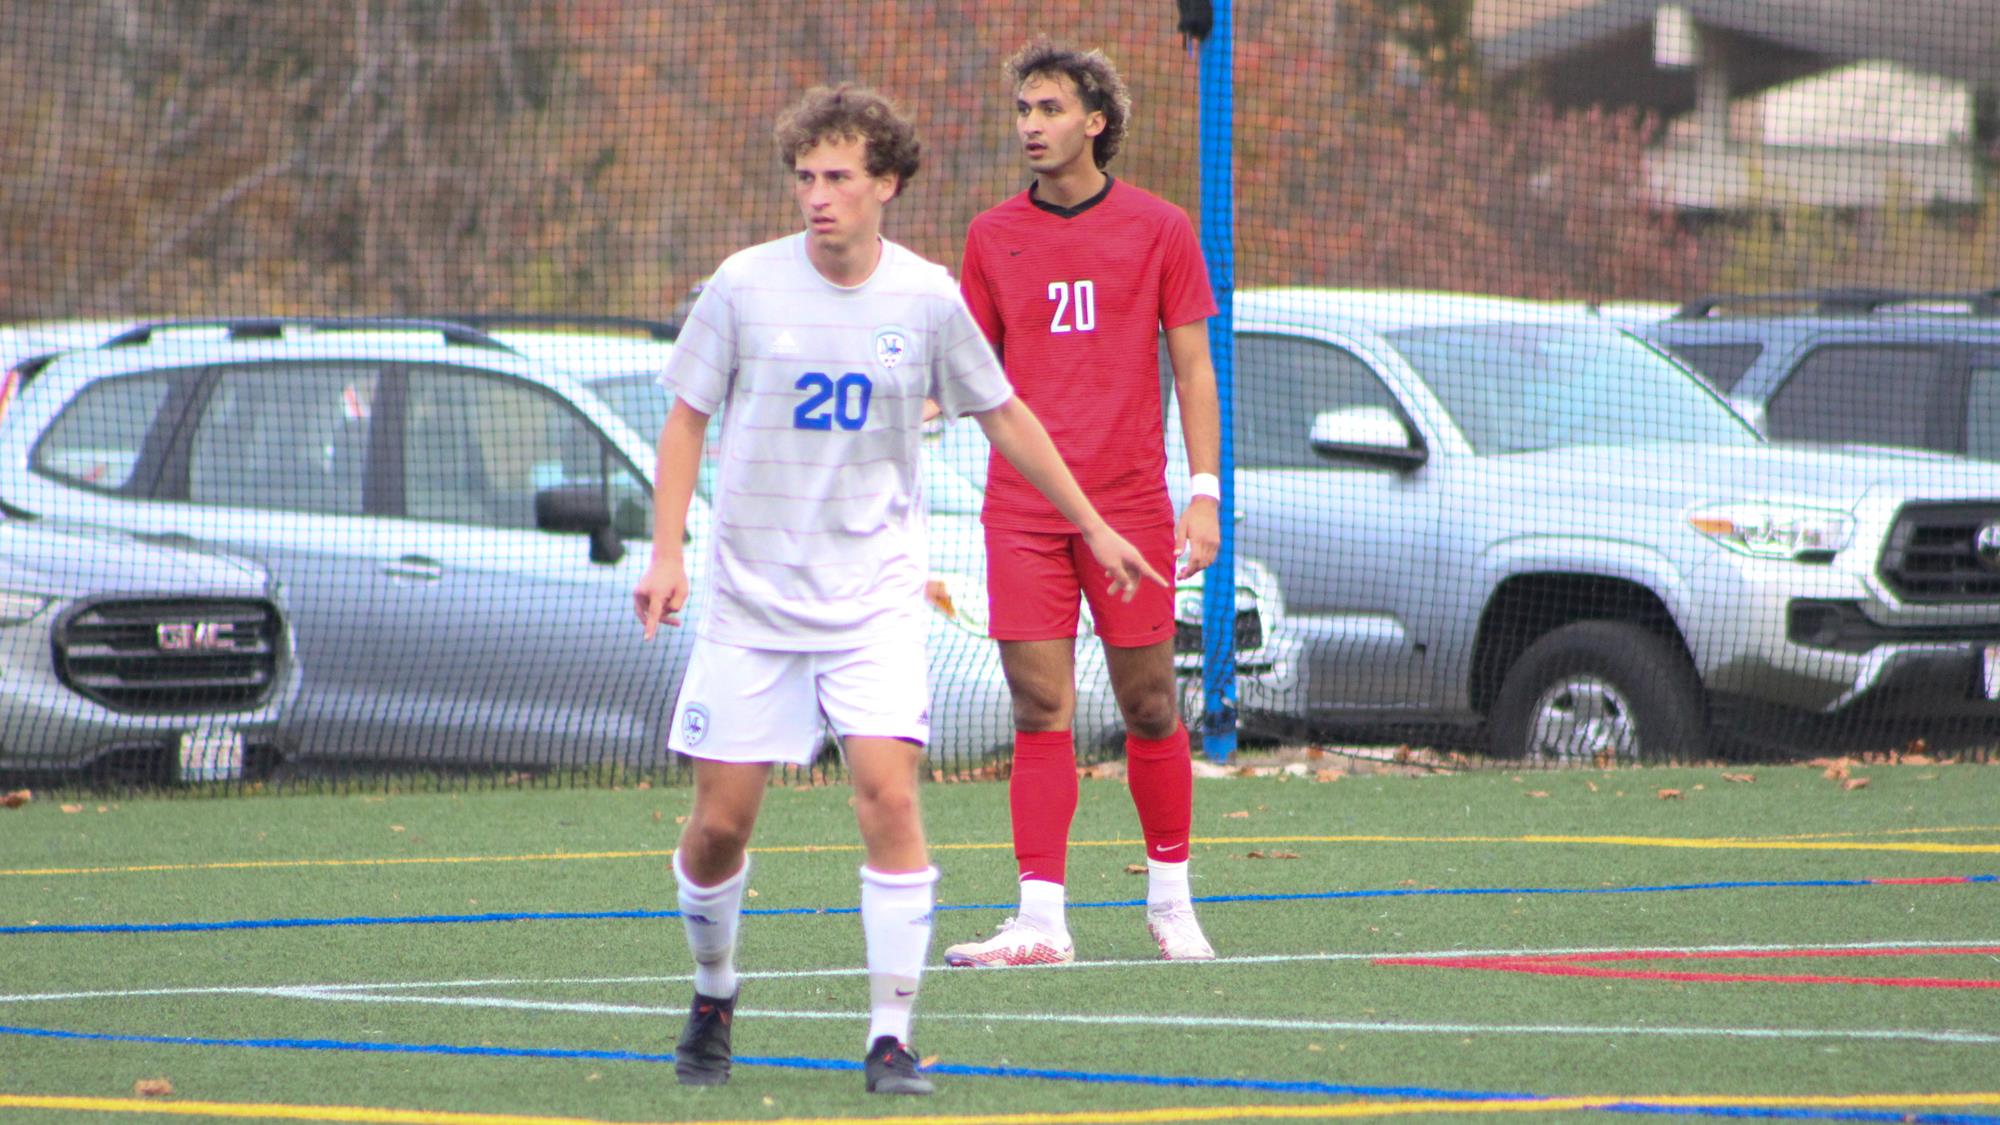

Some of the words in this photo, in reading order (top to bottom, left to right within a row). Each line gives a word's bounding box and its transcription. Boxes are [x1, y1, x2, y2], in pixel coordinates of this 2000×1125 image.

[1048, 280, 1095, 333] 20
[793, 372, 873, 431] 20
[157, 622, 235, 650] GMC
